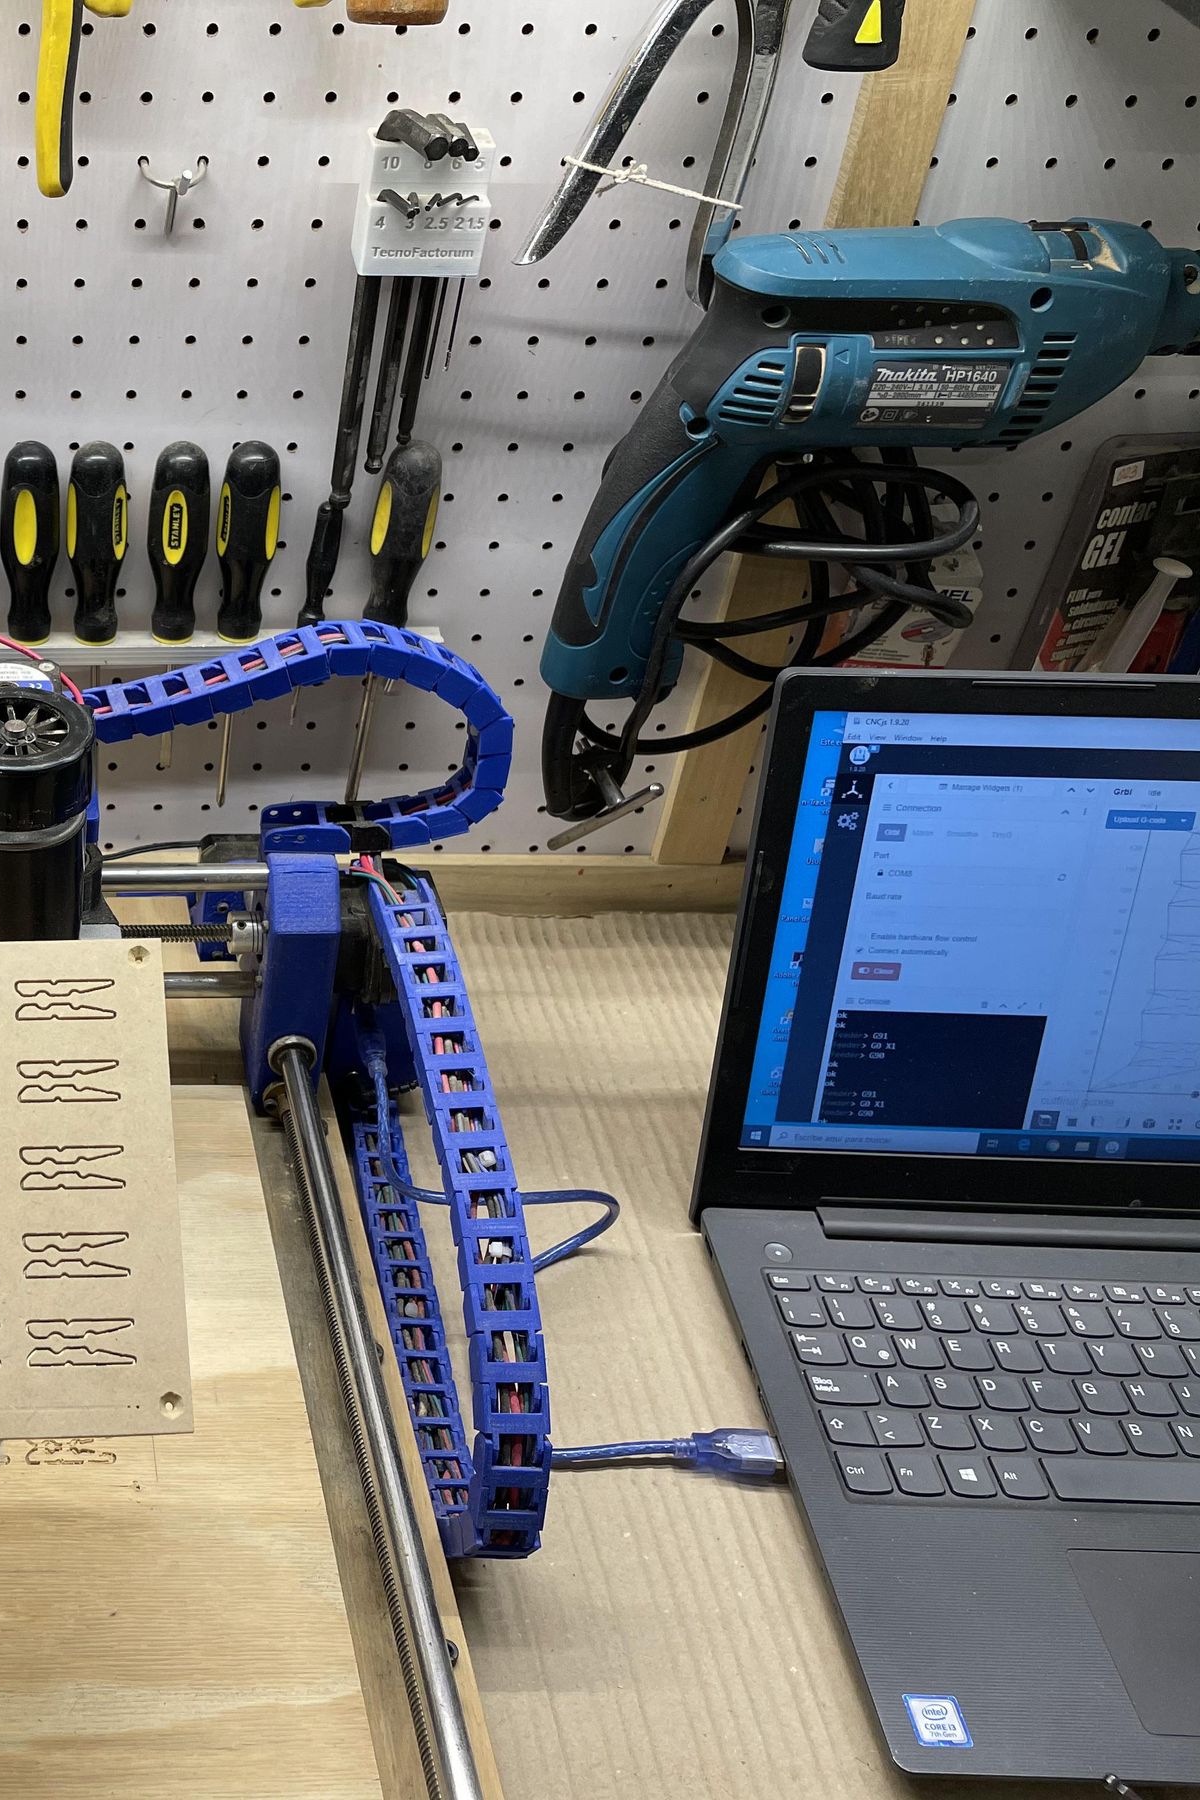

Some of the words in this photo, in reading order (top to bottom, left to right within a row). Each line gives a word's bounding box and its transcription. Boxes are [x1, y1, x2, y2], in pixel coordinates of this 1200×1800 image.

[381, 156, 399, 169] 10
[452, 158, 462, 169] 6
[474, 157, 486, 169] 5
[374, 216, 385, 229] 4
[405, 219, 414, 229] 3
[424, 217, 449, 230] 2.5
[454, 217, 464, 229] 2
[467, 218, 484, 229] 1.5
[372, 247, 474, 258] TecnoFactorum
[945, 371, 997, 382] HP1640
[170, 505, 183, 548] STANLEY
[1080, 530, 1128, 571] GEL
[896, 804, 942, 812] Connection
[901, 948, 948, 957] automatically
[837, 1311, 845, 1322] 1
[884, 1314, 895, 1323] 2
[932, 1315, 943, 1325] 3
[980, 1317, 990, 1326] 4
[1027, 1319, 1038, 1328] 5
[1075, 1320, 1086, 1330] 6
[1122, 1322, 1131, 1331] 7
[1170, 1324, 1180, 1333] 8
[852, 1336, 867, 1348] Q
[899, 1338, 916, 1350] W
[948, 1340, 962, 1352] E
[996, 1342, 1012, 1353] R
[1044, 1344, 1056, 1355] T
[1092, 1345, 1105, 1356] Y
[1140, 1346, 1155, 1358] U
[887, 1376, 899, 1388] A
[933, 1377, 947, 1389] S
[982, 1380, 996, 1391] D
[1031, 1380, 1043, 1392] F
[1082, 1383, 1098, 1395] G
[1130, 1385, 1145, 1396] H
[1182, 1387, 1190, 1398] J
[928, 1417, 942, 1429] Z
[978, 1418, 993, 1431] X
[1030, 1420, 1044, 1432] C
[1078, 1422, 1091, 1434] V
[1128, 1424, 1143, 1436] B
[1177, 1426, 1194, 1438] N
[846, 1466, 865, 1475] Ctrl
[900, 1468, 913, 1476] Fn
[1004, 1471, 1018, 1480] Alt
